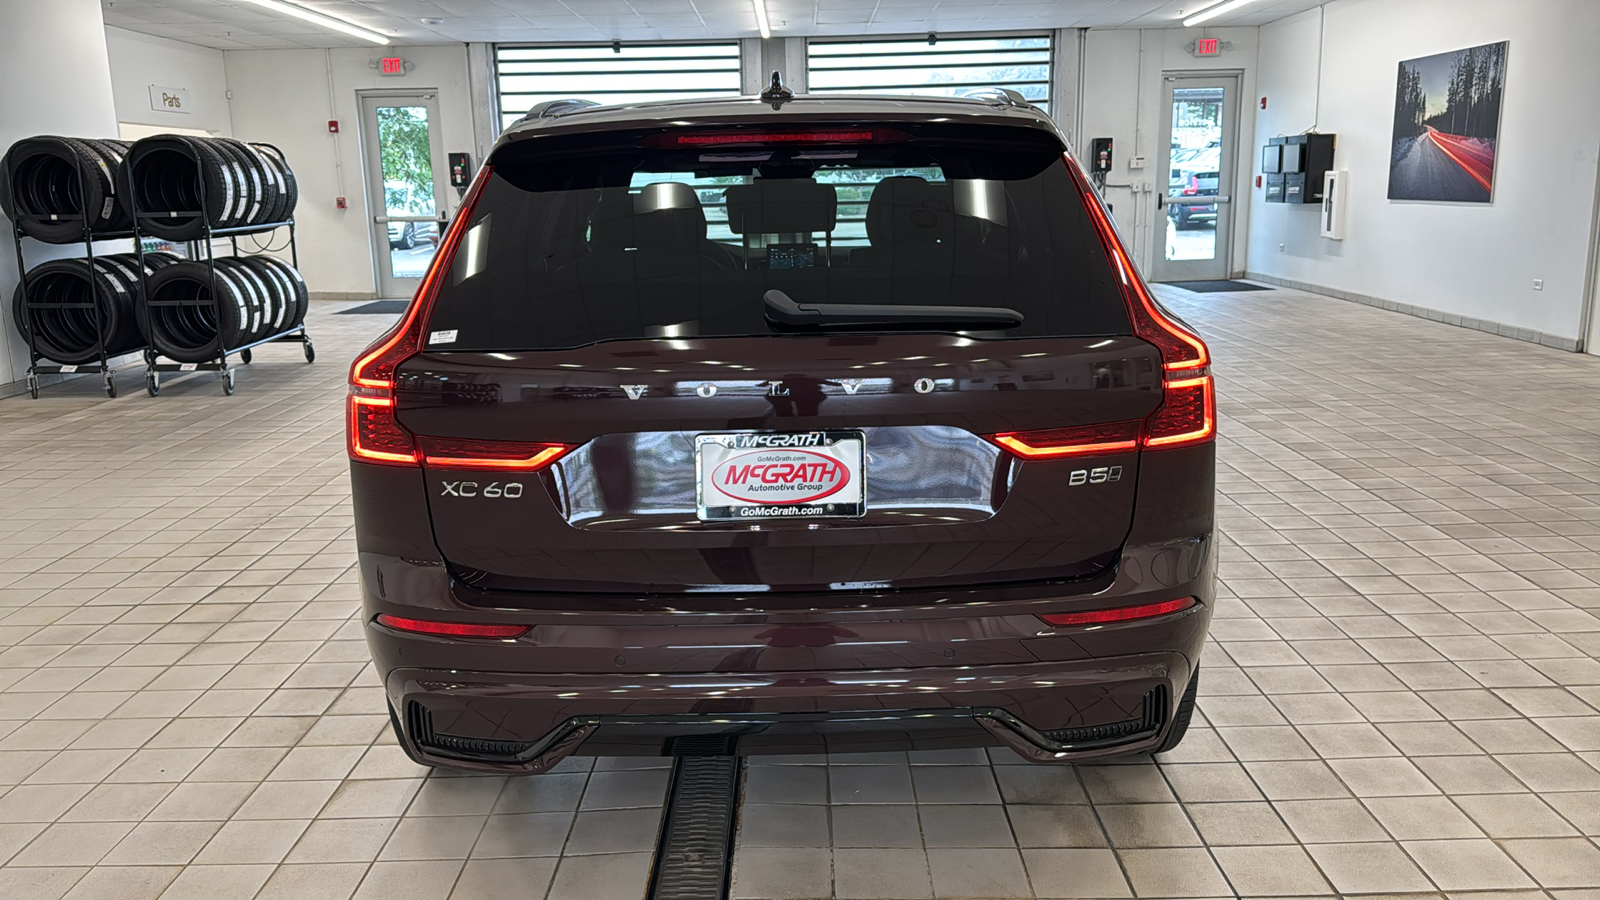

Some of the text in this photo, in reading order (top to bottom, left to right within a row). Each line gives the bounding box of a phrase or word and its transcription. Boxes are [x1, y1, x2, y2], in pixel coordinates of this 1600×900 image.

[1199, 39, 1217, 53] EXIT
[382, 58, 400, 73] EXIT
[162, 92, 181, 108] Parts
[620, 378, 935, 400] VOLVO
[748, 484, 823, 492] Automotive Group
[740, 506, 823, 517] GoMcGrath.com
